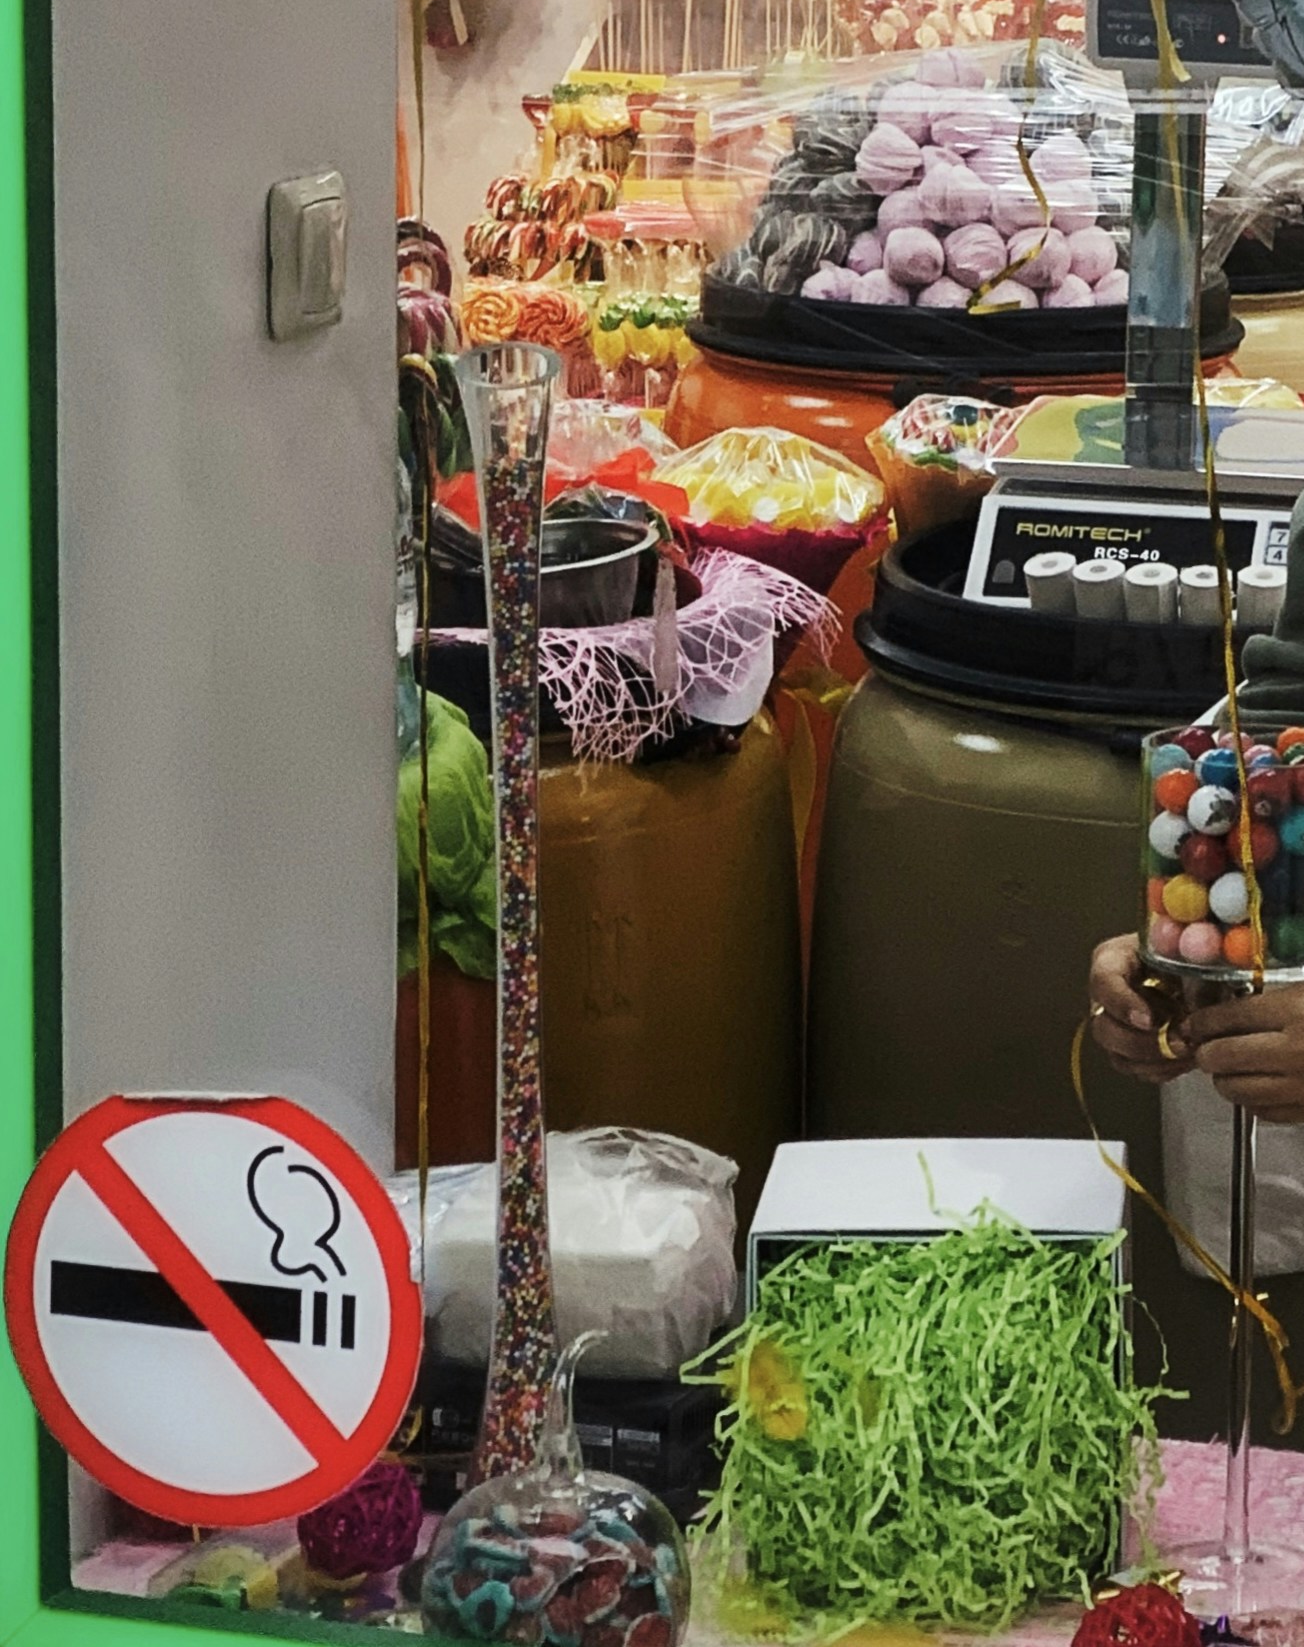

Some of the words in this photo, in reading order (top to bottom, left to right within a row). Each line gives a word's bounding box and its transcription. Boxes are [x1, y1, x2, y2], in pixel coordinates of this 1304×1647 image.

[1016, 522, 1142, 542] ROMITECH
[1277, 531, 1287, 543] 7
[1094, 547, 1160, 561] RCS-40
[1273, 549, 1283, 561] 4
